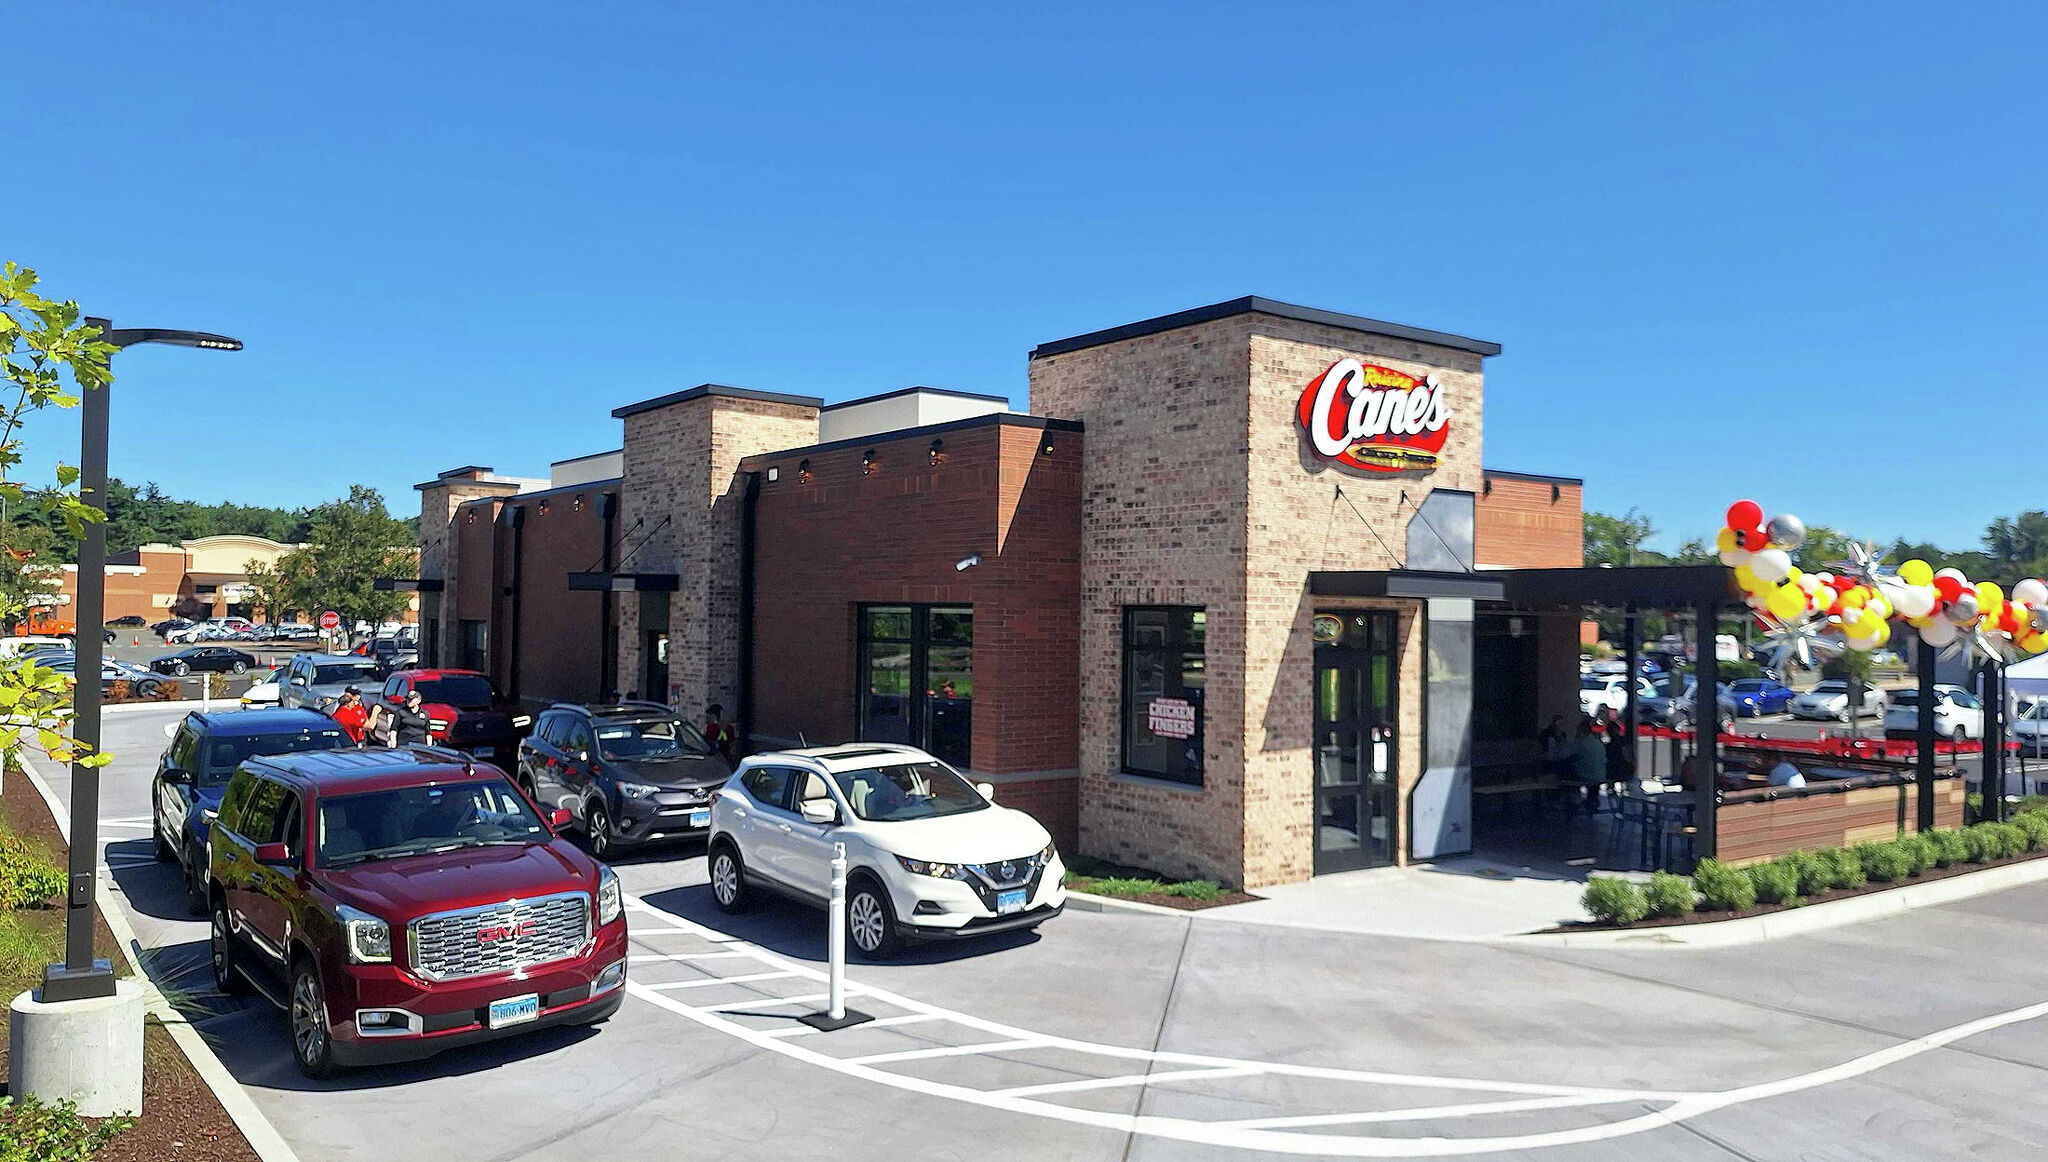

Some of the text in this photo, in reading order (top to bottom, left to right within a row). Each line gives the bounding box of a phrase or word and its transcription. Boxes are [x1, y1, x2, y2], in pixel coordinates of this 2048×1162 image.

[1311, 358, 1453, 457] Cane's
[320, 616, 340, 626] STOP
[477, 921, 537, 943] GMC
